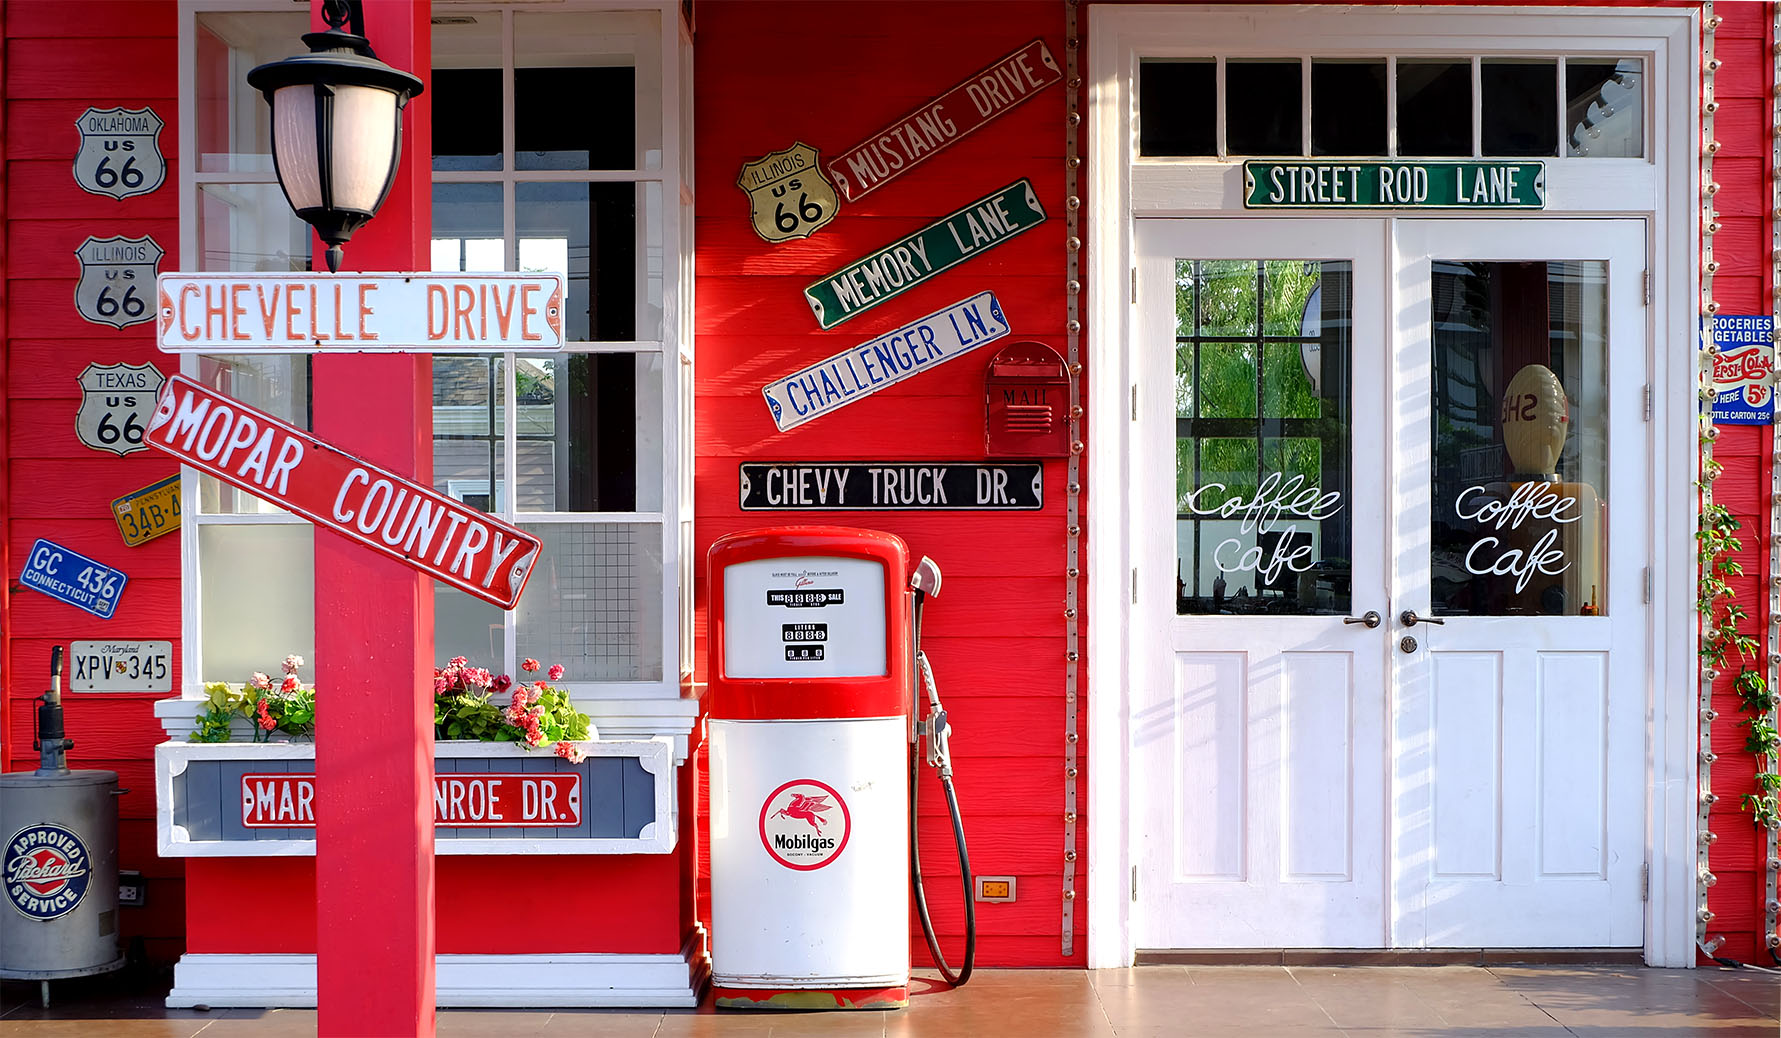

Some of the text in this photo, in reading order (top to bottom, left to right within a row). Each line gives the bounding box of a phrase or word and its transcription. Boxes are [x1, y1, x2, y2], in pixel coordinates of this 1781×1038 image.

[89, 117, 149, 132] OKLAHOMA
[846, 52, 1045, 189] MUSTANG DRIVE
[104, 140, 136, 151] US
[95, 155, 144, 188] 66
[751, 153, 805, 186] ILLINOIS
[1270, 166, 1521, 203] STREET ROD LANE
[771, 178, 803, 197] US
[774, 192, 823, 233] 66
[91, 246, 146, 261] ILLINOIS
[830, 195, 1020, 313] MEMORY LANE
[105, 269, 136, 280] US
[96, 285, 145, 317] 66
[179, 283, 542, 342] CHEVELLE DRIVE
[1700, 330, 1774, 342] GETABLES
[1712, 318, 1771, 330] ROCERIES
[786, 303, 997, 416] CHALLENGER LN.
[95, 373, 146, 388] TEXAS
[106, 396, 137, 407] US
[1003, 389, 1051, 406] MAIL
[1720, 390, 1740, 404] HERE
[97, 412, 145, 444] 66
[1712, 411, 1729, 419] OTTLE
[1730, 411, 1756, 419] CARTON
[165, 390, 520, 588] MOPAR COUNTRY
[766, 468, 1017, 505] CHEVY TRUCK DR.
[1189, 471, 1345, 535] Coffee
[1455, 480, 1583, 530] Coffee
[1213, 524, 1320, 586] Cafe
[1465, 528, 1572, 594] Cafe
[25, 569, 95, 605] CONNECTICUT
[33, 547, 118, 599] GC 436
[101, 644, 141, 657] Maryland
[76, 655, 166, 680] XPV 345
[435, 780, 503, 821] NROE
[522, 780, 567, 821] DR.
[13, 831, 81, 859] APPROVED
[775, 834, 834, 852] Mobilgas
[7, 855, 87, 884] Packard
[12, 885, 78, 913] SERVICE
